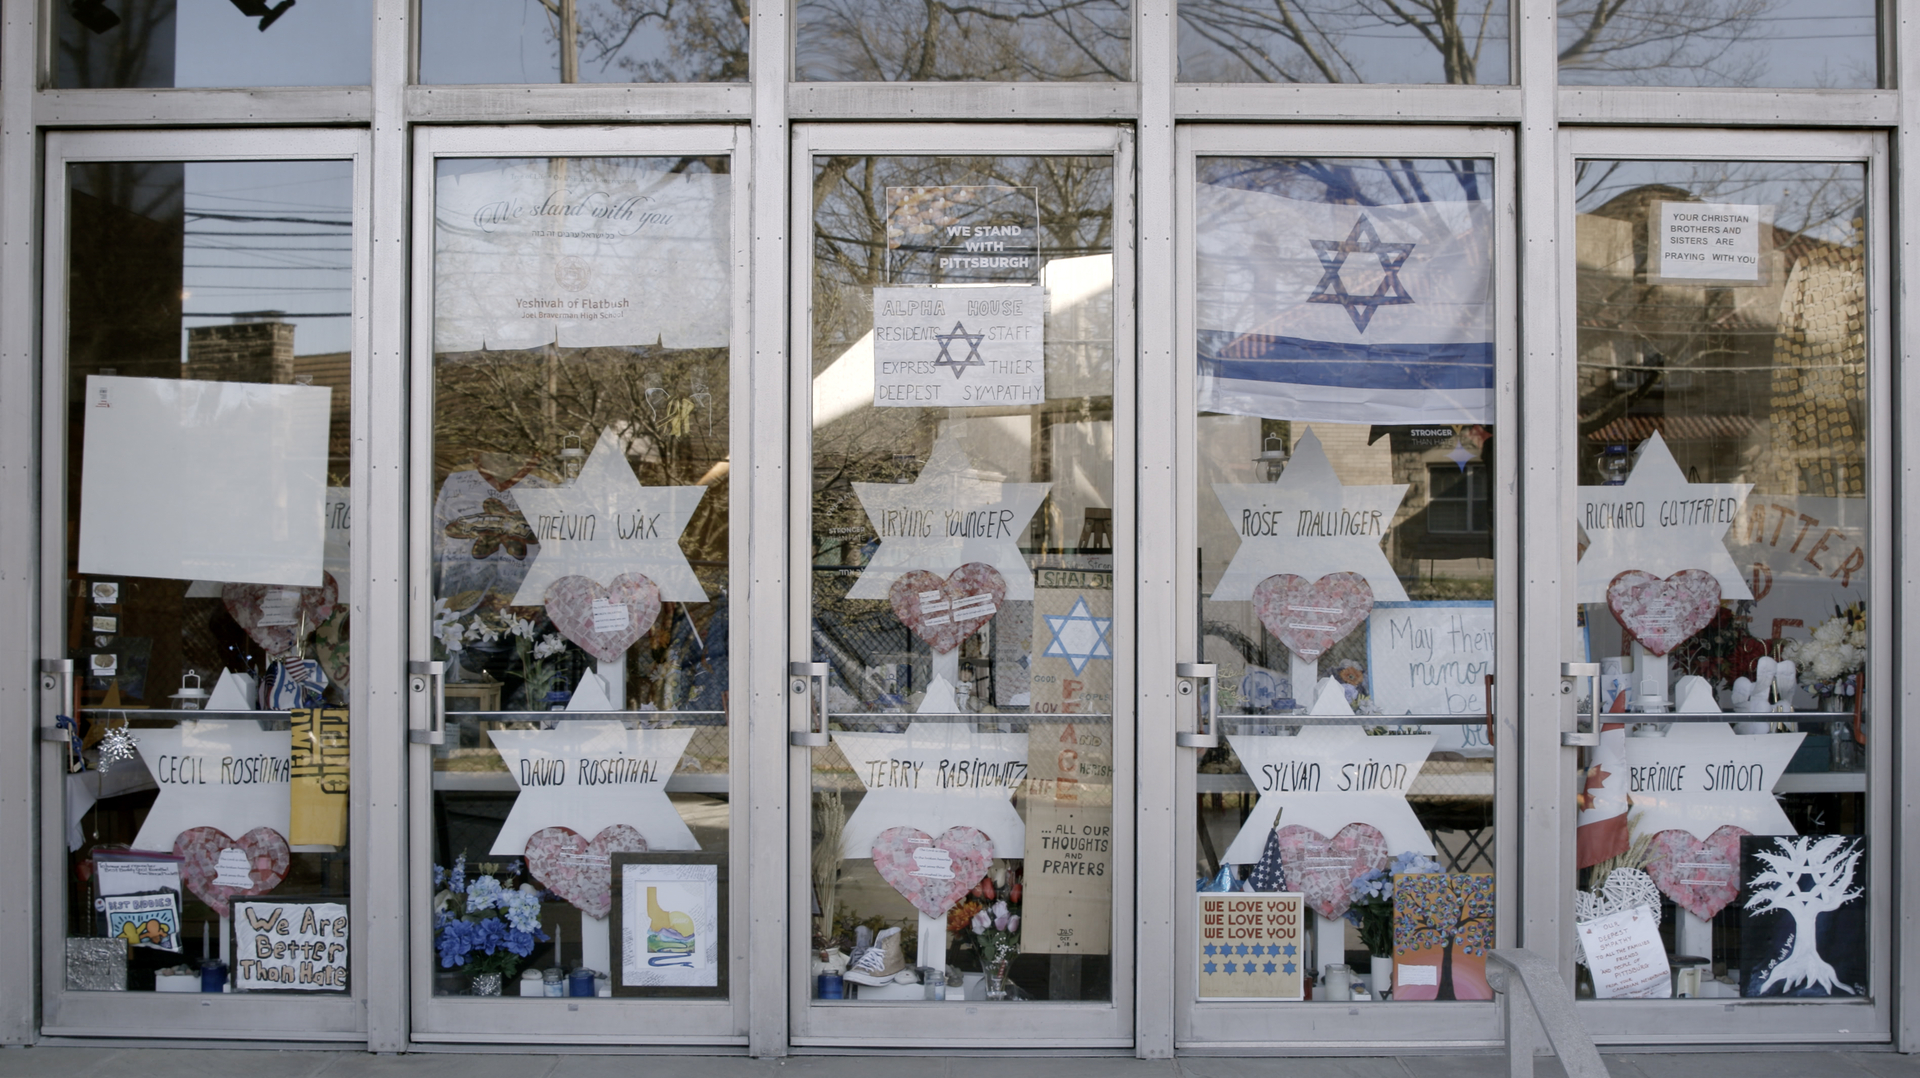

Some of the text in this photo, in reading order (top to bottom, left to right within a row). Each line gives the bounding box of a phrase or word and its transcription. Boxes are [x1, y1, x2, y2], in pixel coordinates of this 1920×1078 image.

[529, 188, 610, 217] stand
[1673, 214, 1749, 223] YOUR CHRISTIAN
[947, 226, 1022, 236] WE STAND
[1670, 225, 1742, 235] BROTHERS AND
[965, 241, 1004, 252] WITH
[1670, 237, 1735, 246] SISTERS ARE
[939, 257, 1029, 269] PITTSBURGH
[1664, 252, 1756, 264] PRAYING WITH YOU
[516, 298, 630, 309] Yeshivah of Flatbush
[882, 300, 1024, 316] ALPHA HOUSE
[521, 311, 537, 319] Joel
[539, 311, 579, 319] Braverman
[580, 311, 598, 320] High
[876, 326, 1033, 341] RESIDENTS STAFF
[882, 360, 1035, 374] EXPRESS THIER
[879, 385, 1043, 400] DEEPEST SYMPATHY
[1411, 429, 1453, 437] STRONGER
[616, 512, 661, 540] WAX
[880, 508, 1015, 539] IRVING YOUNGER
[1241, 508, 1283, 537] ROSE
[1390, 616, 1433, 662] May
[1034, 675, 1056, 683] GOOD
[1445, 687, 1481, 715] be
[158, 754, 290, 785] CECIL ROSENTHA
[520, 757, 658, 786] DAVID ROSENTHAL
[865, 758, 923, 788] JERRY
[1083, 826, 1110, 836] OUR
[1042, 836, 1109, 852] THOUGHTS
[1043, 860, 1104, 876] PRAYERS
[1204, 901, 1297, 913] WE LOVE YOU
[246, 907, 347, 937] We Are
[1204, 914, 1297, 926] WE LOVE YOU
[1204, 928, 1297, 940] WE LOVE YOU
[255, 935, 345, 962] Better
[240, 960, 346, 986] Than Hate
